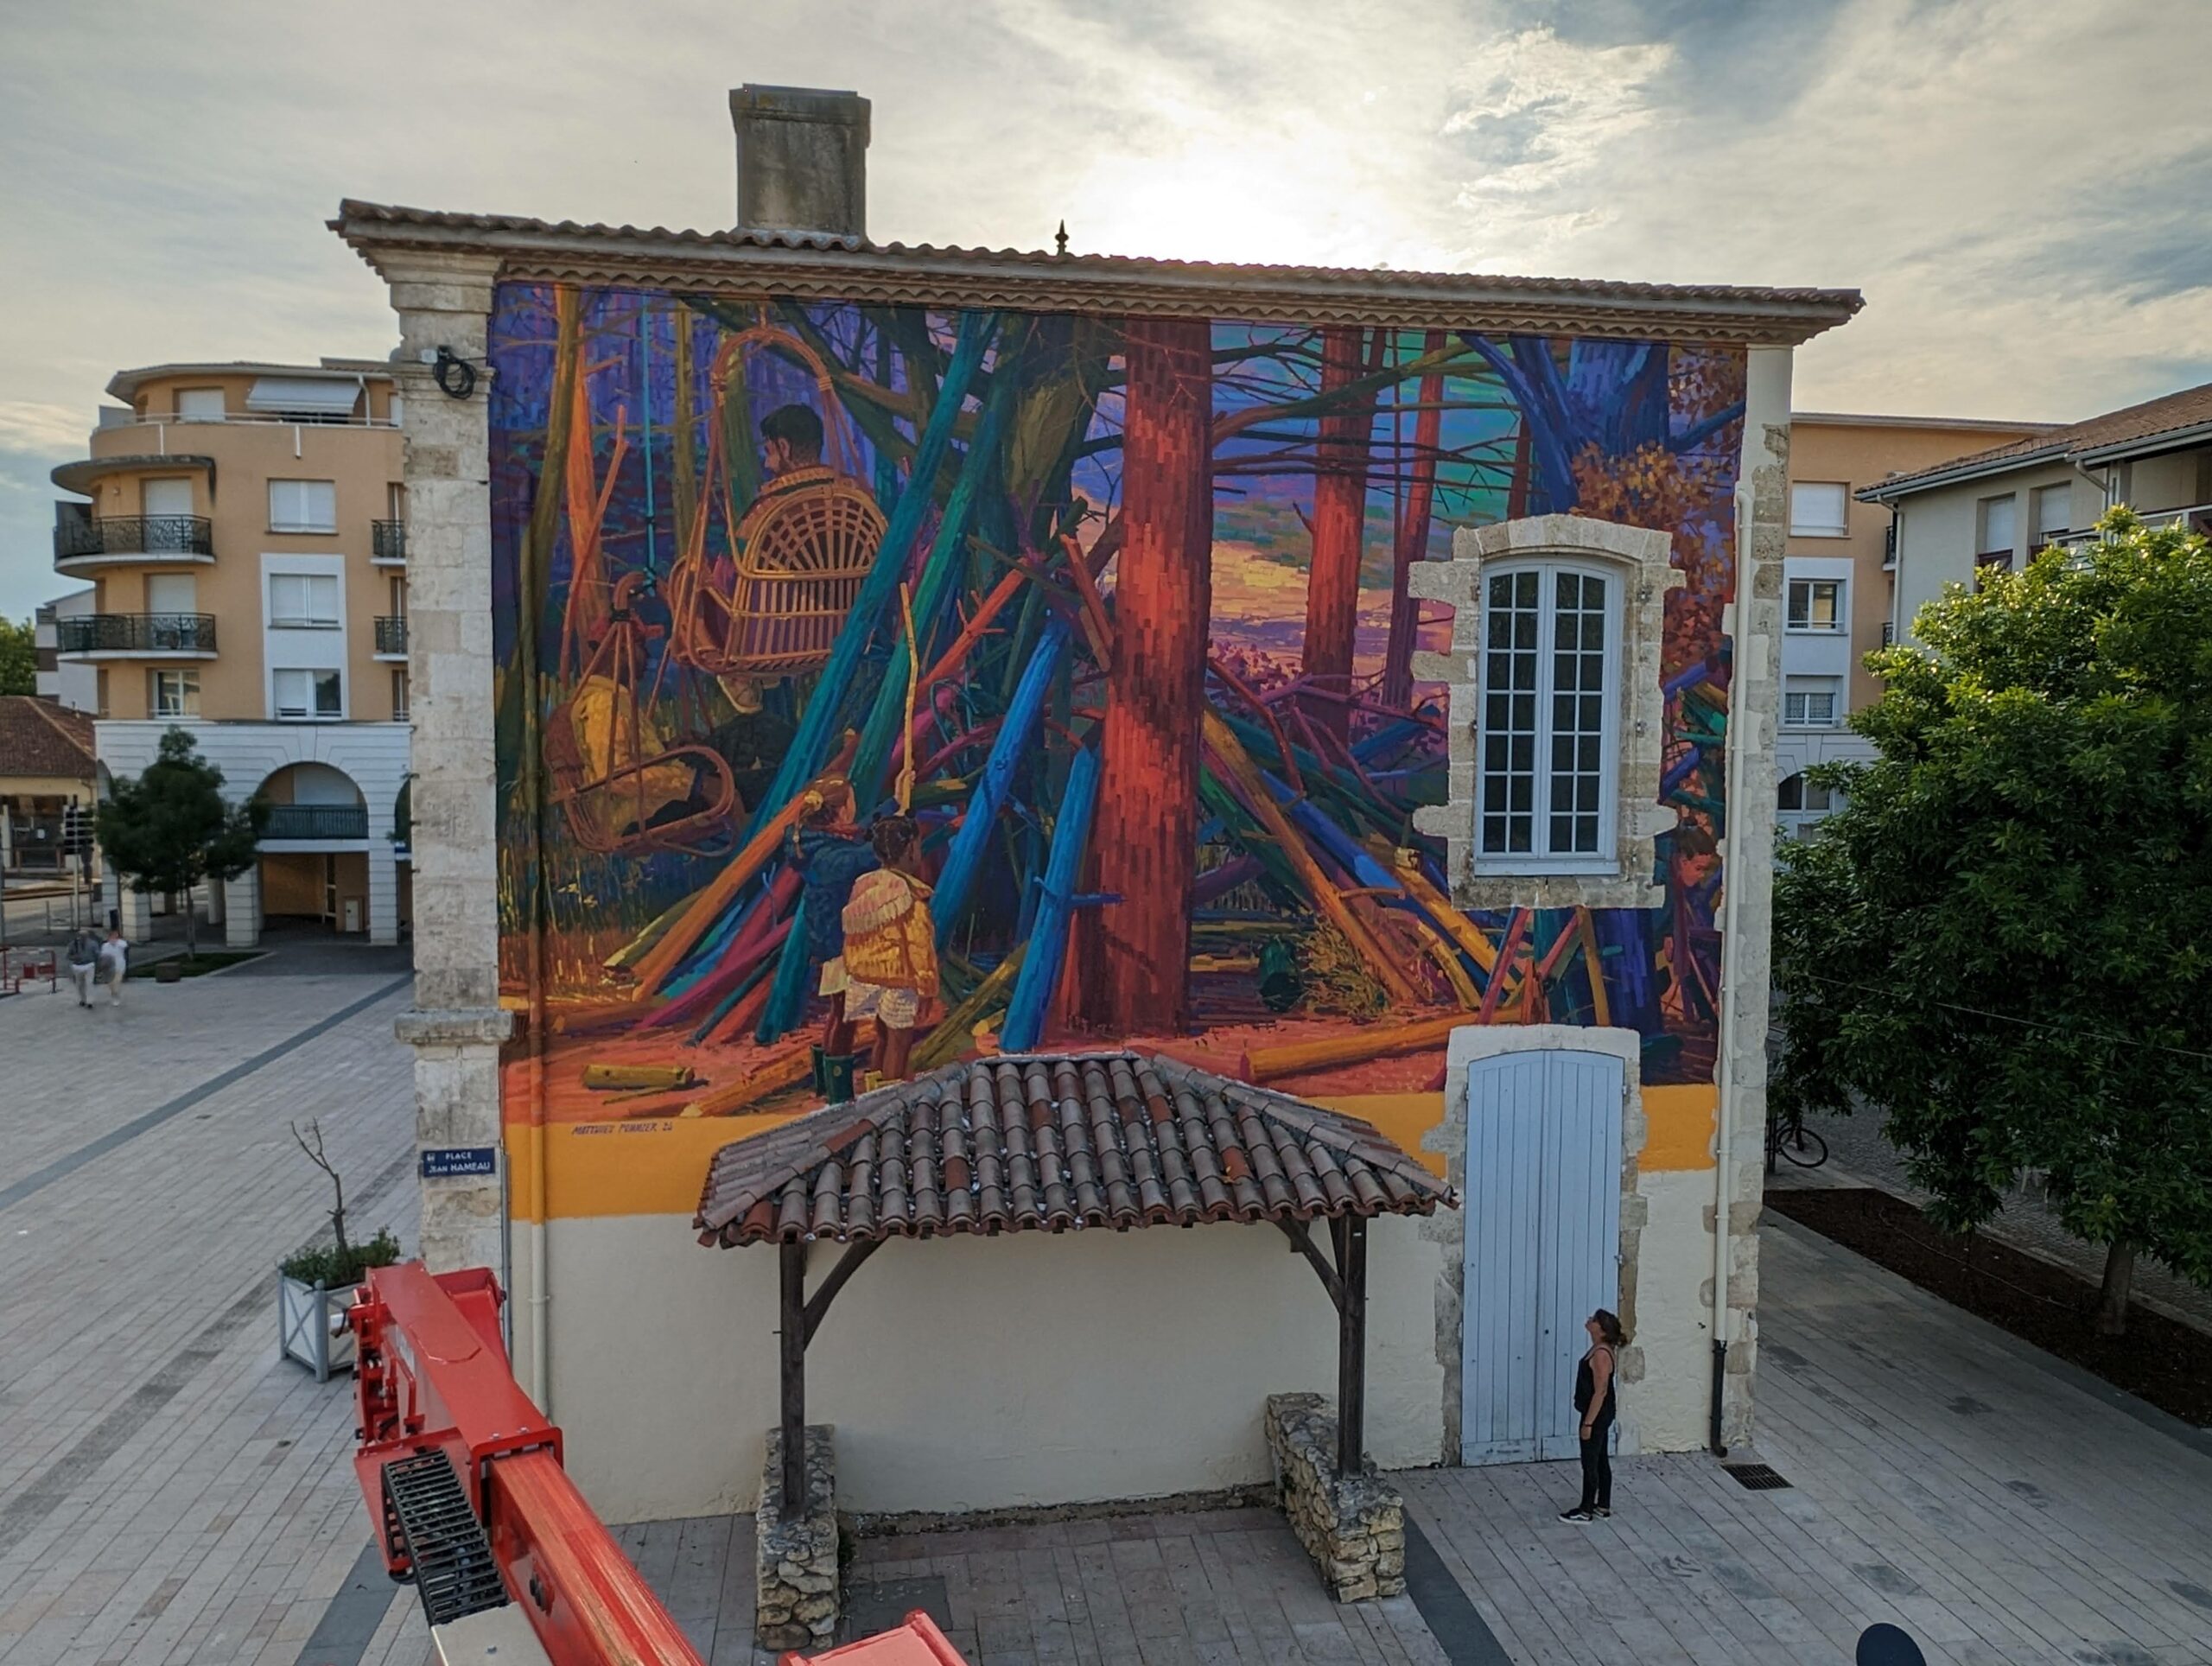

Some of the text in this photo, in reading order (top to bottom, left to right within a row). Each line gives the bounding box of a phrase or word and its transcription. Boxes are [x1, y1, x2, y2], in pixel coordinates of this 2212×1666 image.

[445, 1151, 473, 1160] PLACE
[429, 1161, 491, 1173] JEAN HAMEAU
